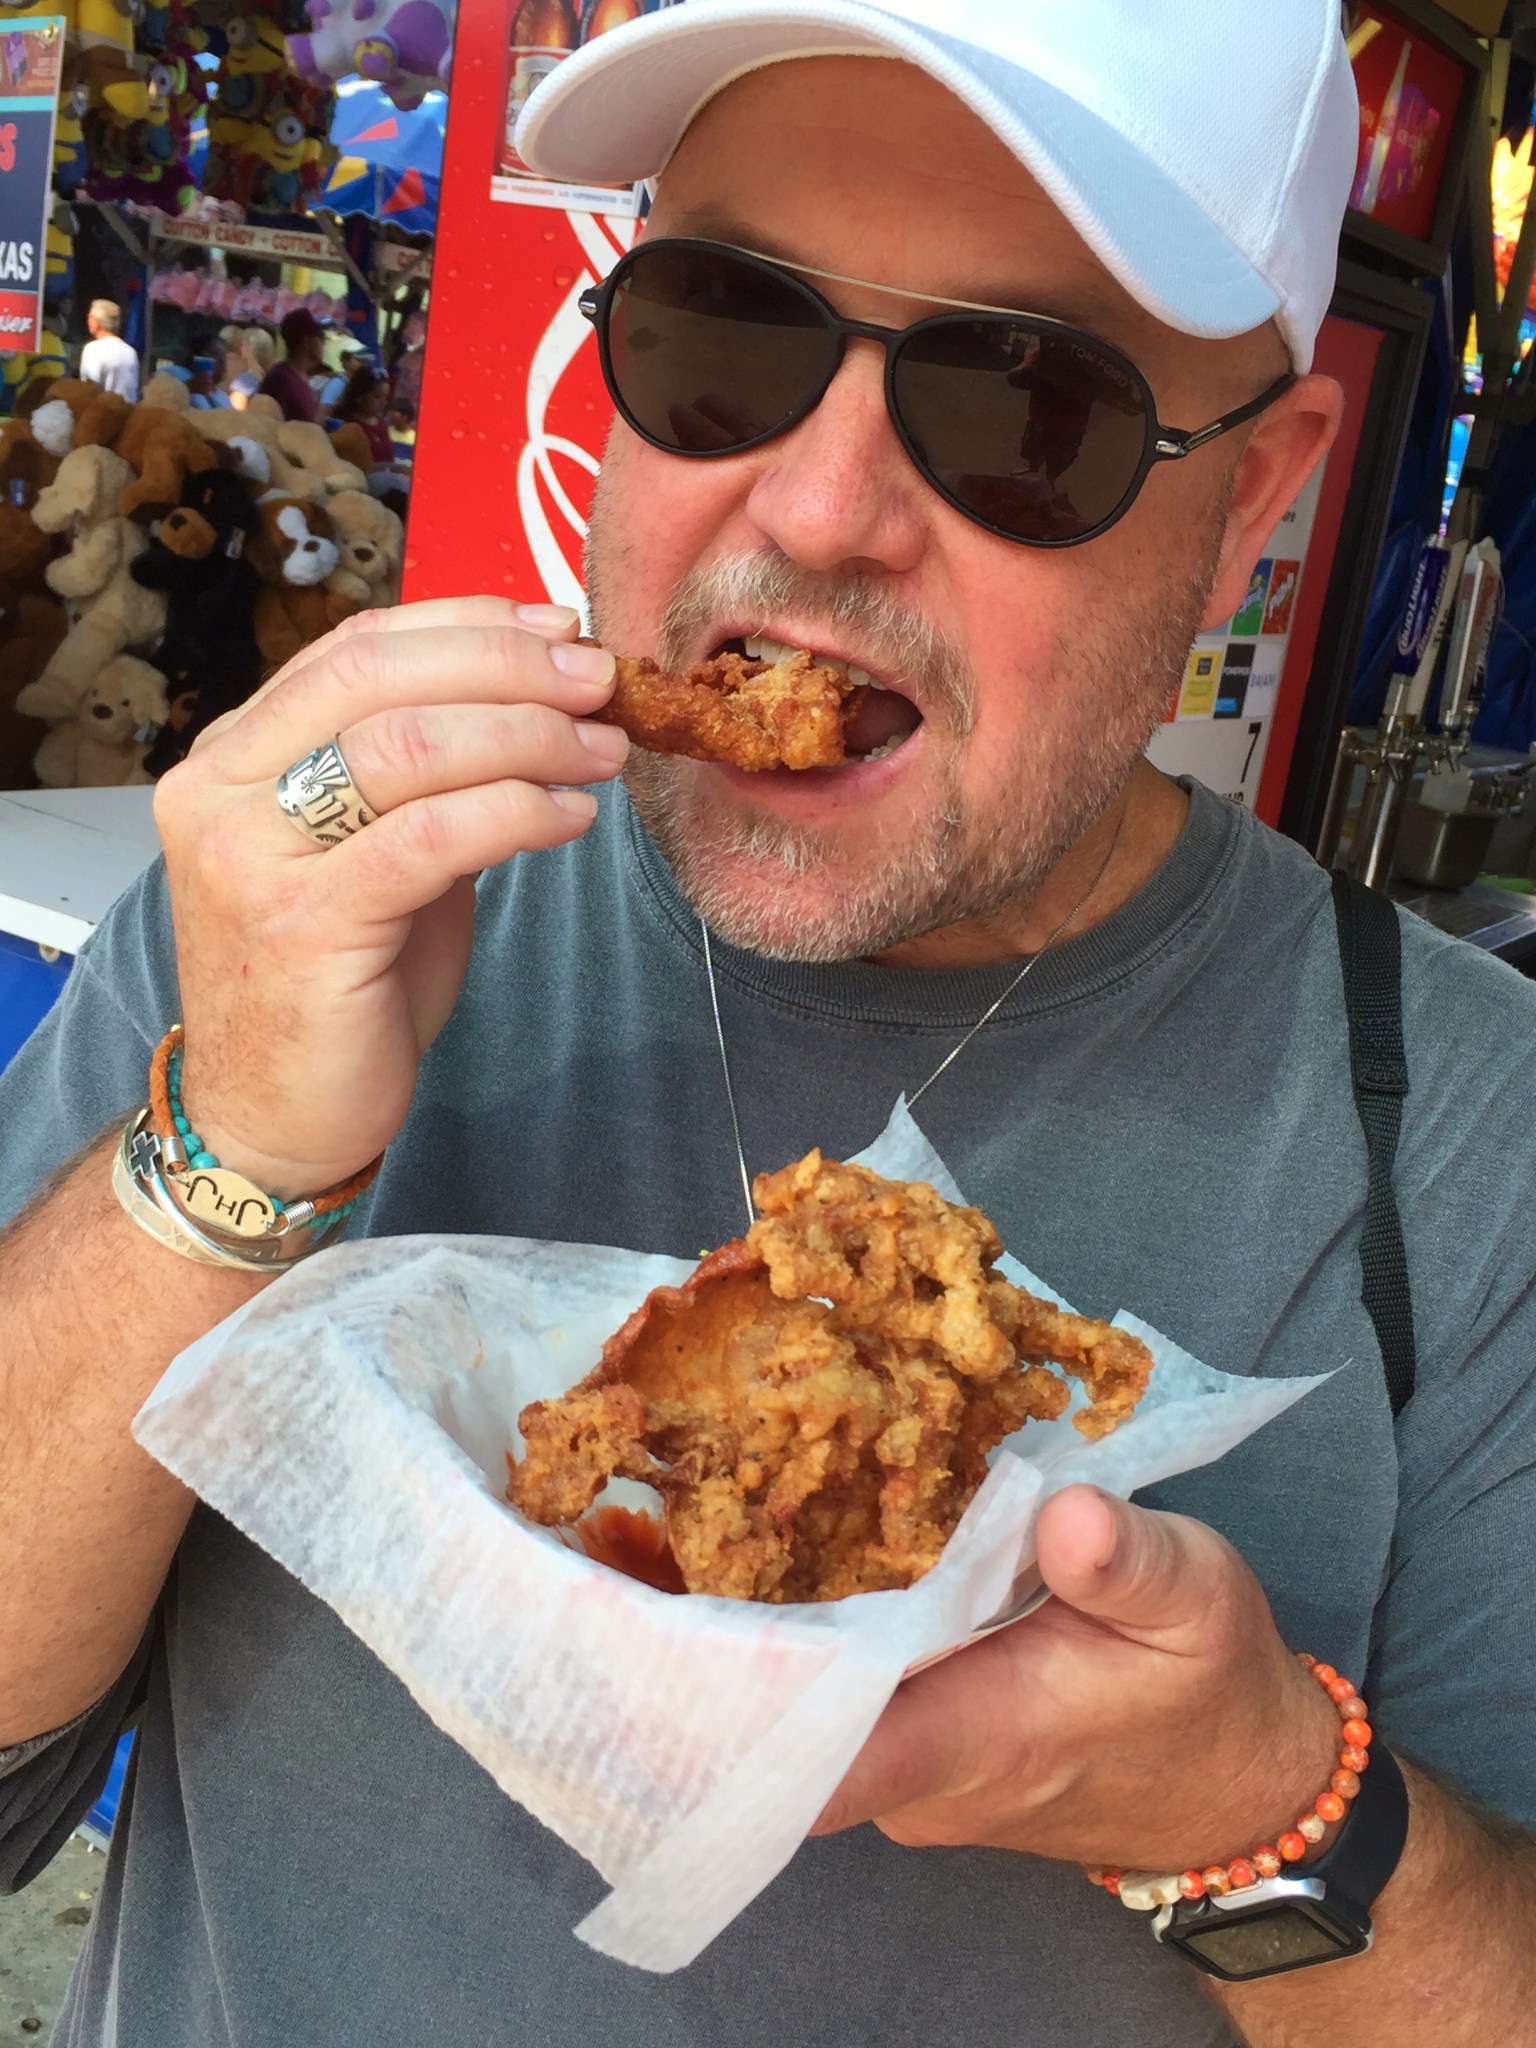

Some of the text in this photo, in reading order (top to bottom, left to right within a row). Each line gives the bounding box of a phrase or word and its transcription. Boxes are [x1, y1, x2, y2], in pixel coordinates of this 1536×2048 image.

[215, 226, 256, 246] CANDY
[272, 233, 321, 254] COTTON
[1070, 343, 1130, 388] TOM FORD
